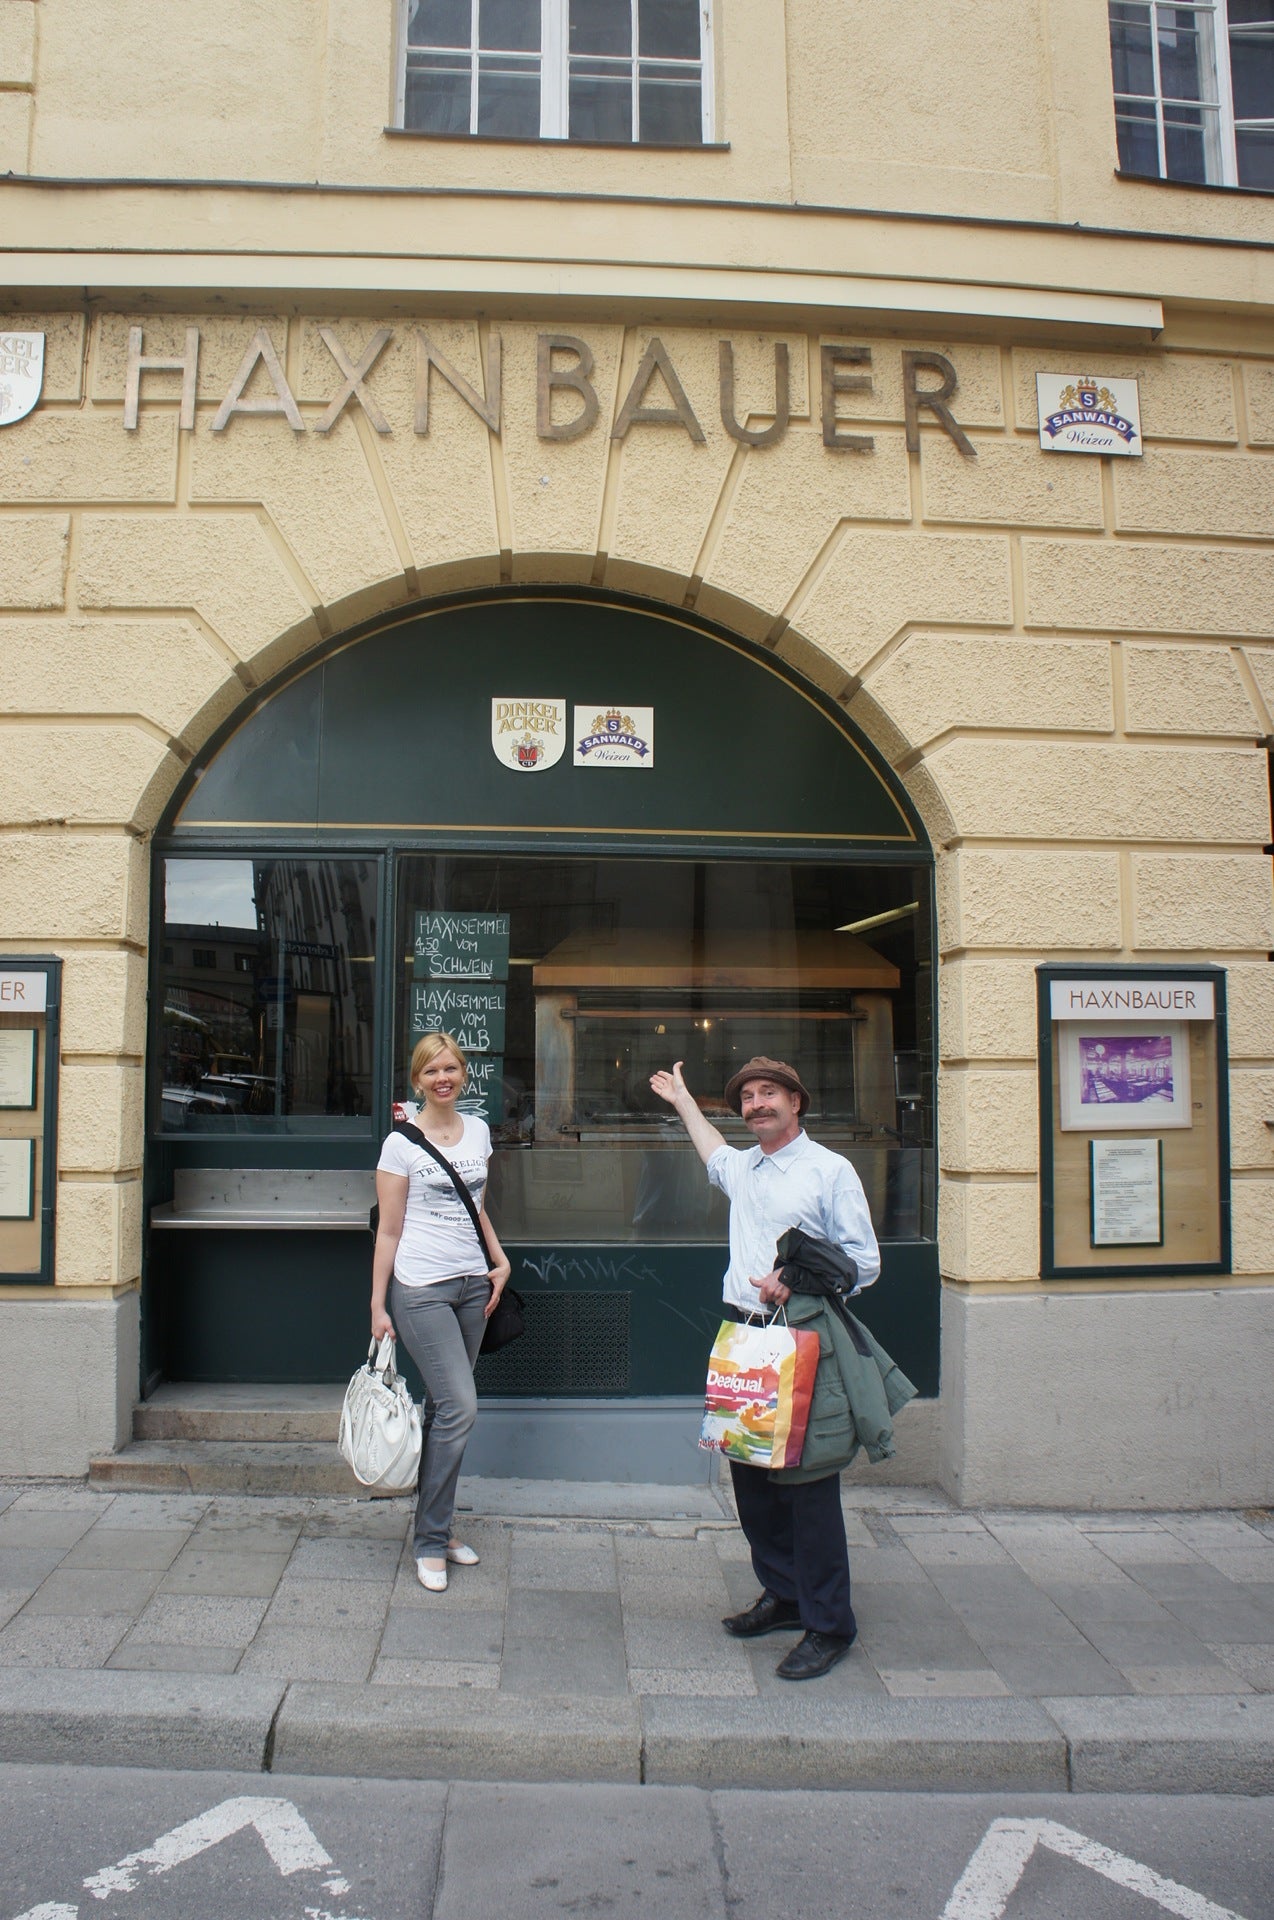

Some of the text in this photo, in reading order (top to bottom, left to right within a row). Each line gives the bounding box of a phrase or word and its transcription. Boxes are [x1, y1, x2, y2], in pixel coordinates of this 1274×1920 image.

[123, 325, 978, 456] HAXNBAUER
[1083, 393, 1093, 406] S
[1052, 412, 1127, 431] SANWALD
[1066, 431, 1113, 446] Weizen
[496, 702, 562, 721] DINKEL
[498, 716, 559, 735] ACKER
[584, 735, 642, 750] SANWALD
[594, 750, 631, 761] Weizen
[420, 915, 510, 941] HAXNSEMMEL
[456, 939, 478, 952] VOM
[429, 954, 494, 974] SCHWEIN
[416, 989, 505, 1012] HAXNSEMMEL
[1070, 990, 1197, 1009] HAXNBAUER
[460, 1012, 486, 1028] VOM
[416, 1164, 443, 1178] TRU
